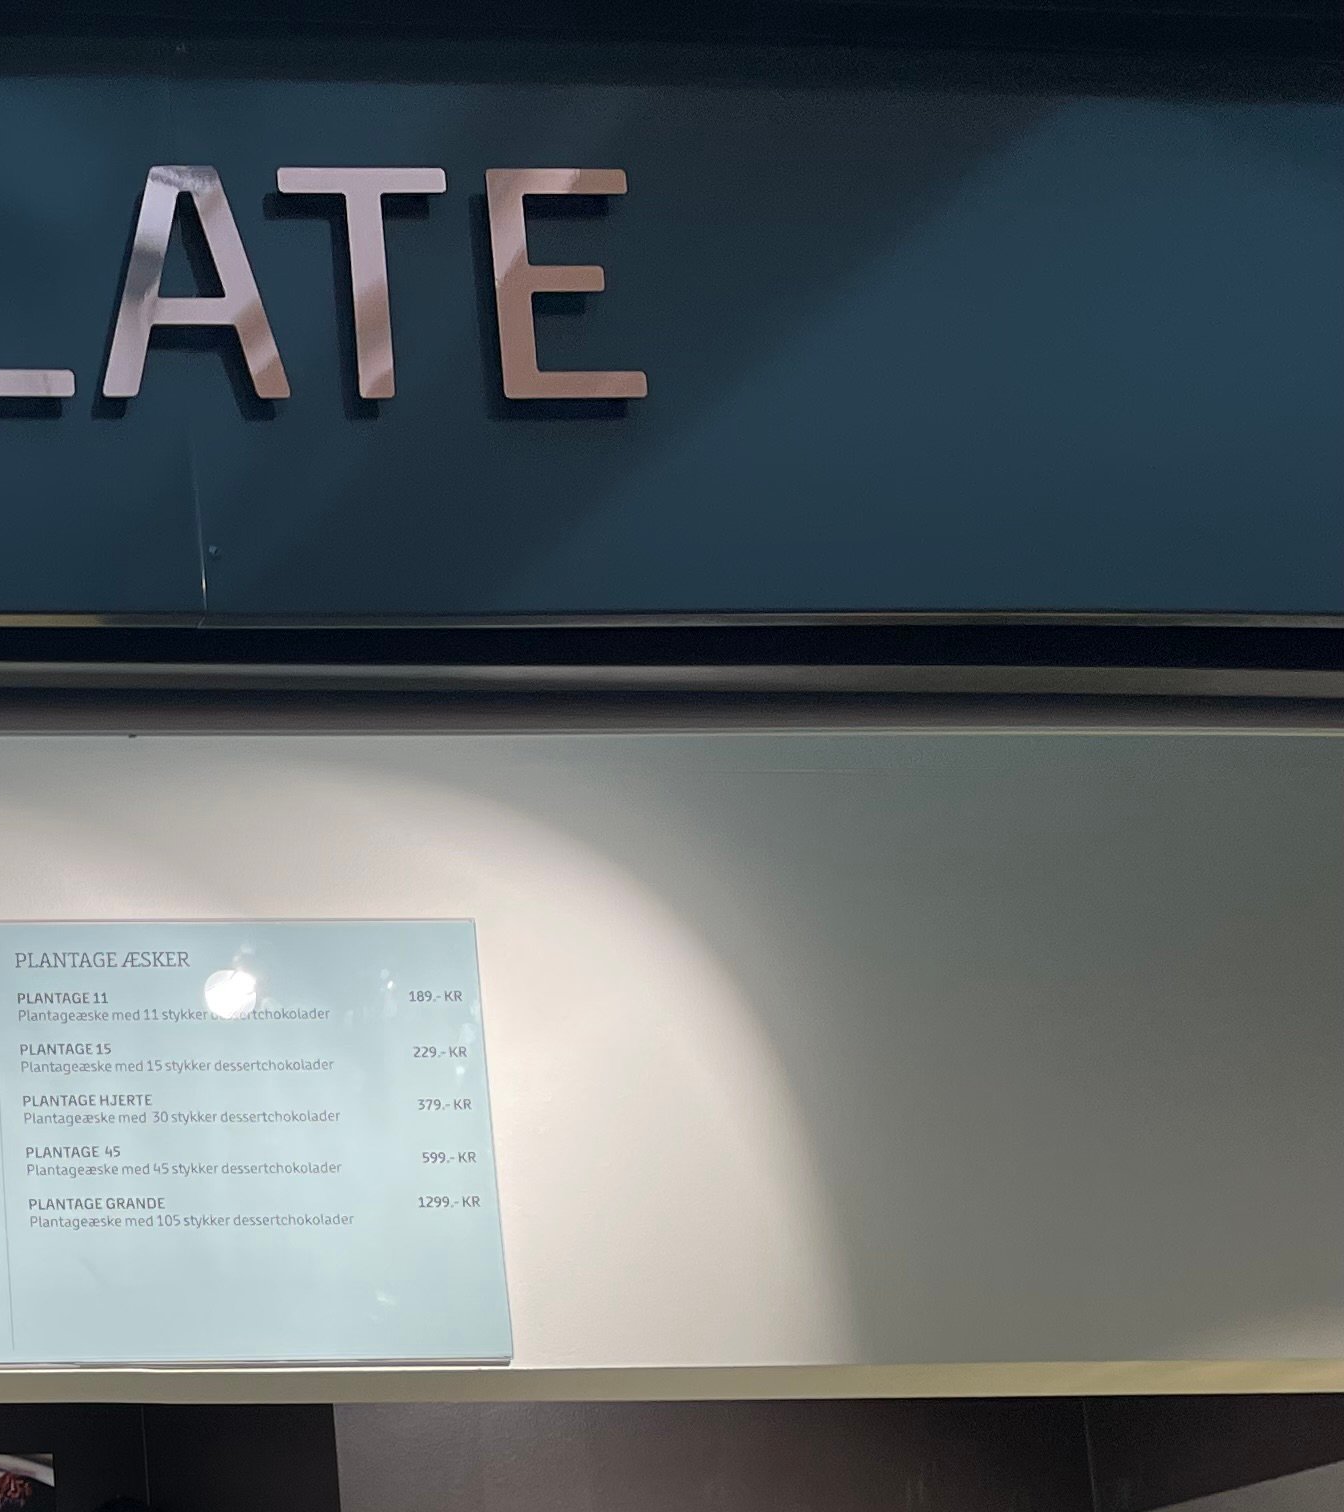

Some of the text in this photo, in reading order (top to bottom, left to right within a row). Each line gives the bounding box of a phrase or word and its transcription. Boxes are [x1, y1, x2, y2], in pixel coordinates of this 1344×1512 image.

[14, 951, 191, 969] PLANTAGE ÆSKER
[22, 1093, 153, 1108] PLANTAGE HJERTE
[417, 1098, 473, 1111] 379.- KR
[28, 1197, 166, 1211] PLANTAGE GRANDE
[417, 1195, 481, 1209] 1299.- KR
